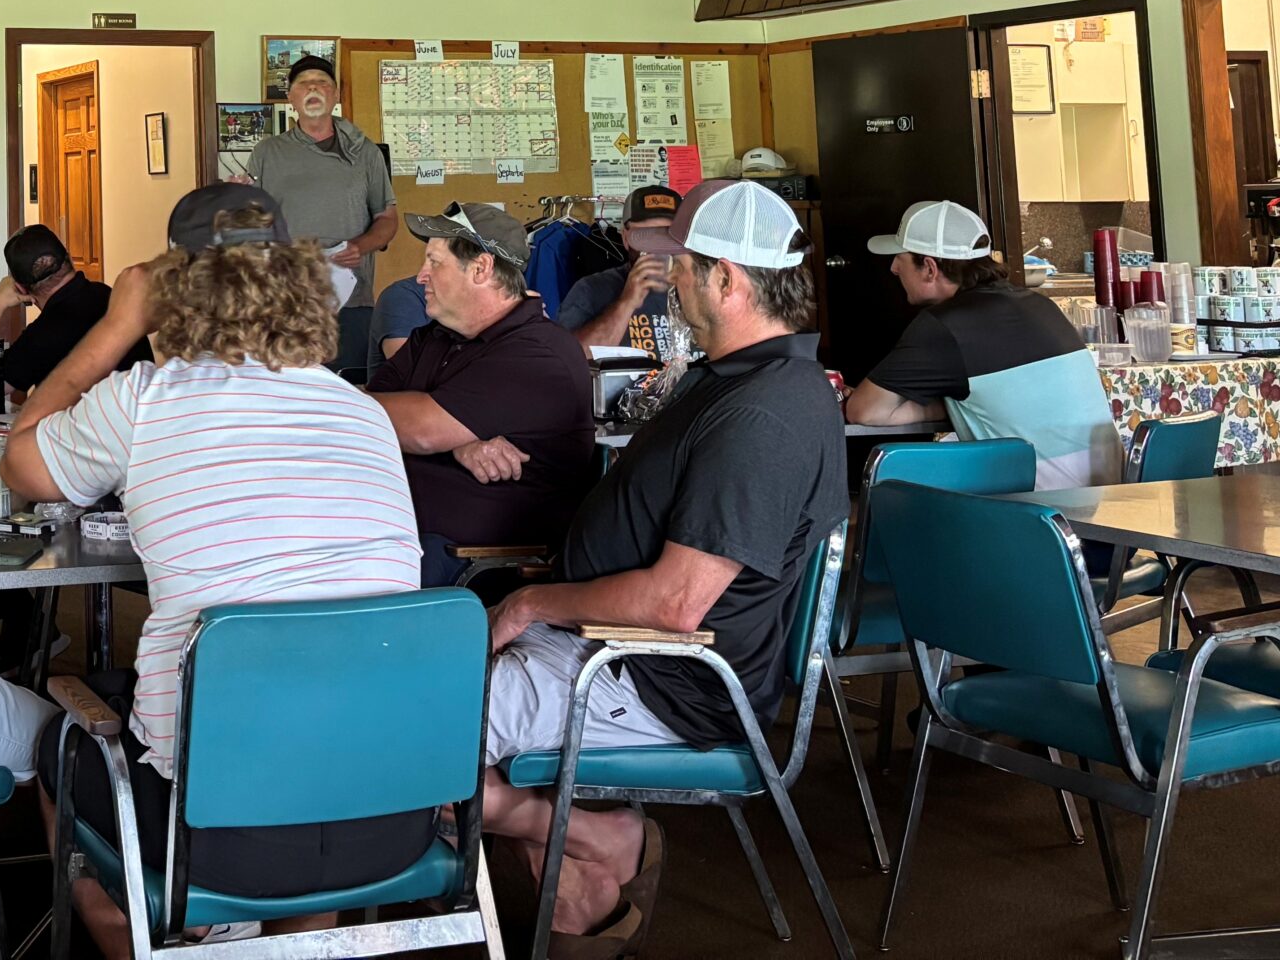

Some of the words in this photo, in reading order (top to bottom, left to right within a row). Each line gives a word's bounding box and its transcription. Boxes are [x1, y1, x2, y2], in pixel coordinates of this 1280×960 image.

[416, 42, 439, 54] JUNE
[494, 44, 517, 59] JULY
[635, 63, 681, 71] Identification
[591, 111, 614, 120] Who's
[592, 121, 610, 130] your
[416, 165, 444, 179] AUGUST
[628, 314, 649, 326] NO
[629, 326, 653, 339] NO
[631, 339, 656, 351] NO
